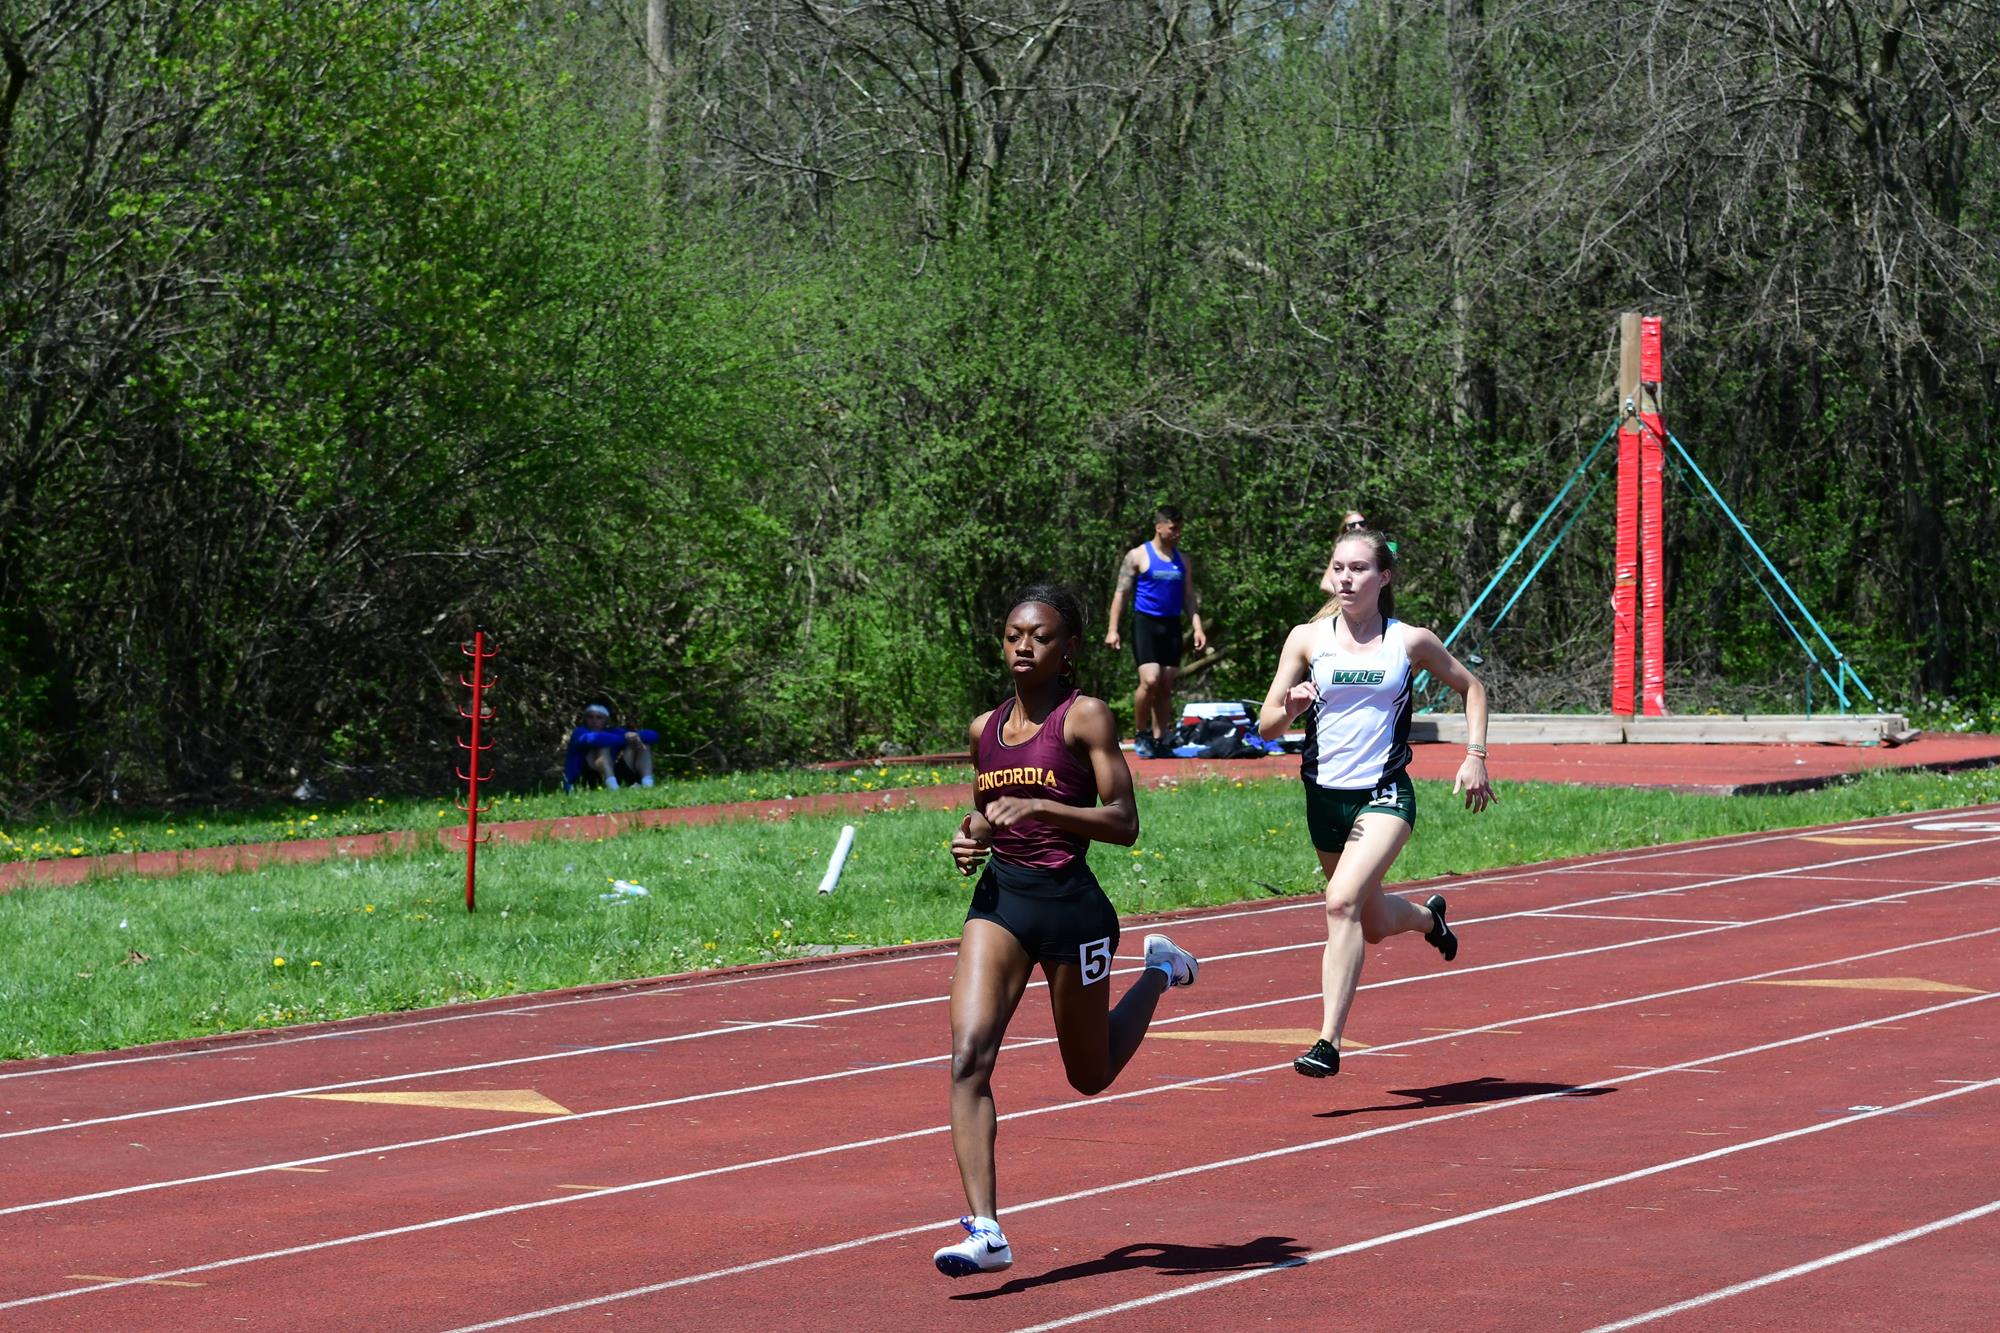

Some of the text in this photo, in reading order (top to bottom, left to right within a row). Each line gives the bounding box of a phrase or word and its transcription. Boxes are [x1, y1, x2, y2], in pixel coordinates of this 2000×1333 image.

[1332, 670, 1385, 684] WLC
[977, 767, 1057, 791] ONCORDIA
[1085, 942, 1107, 980] 5
